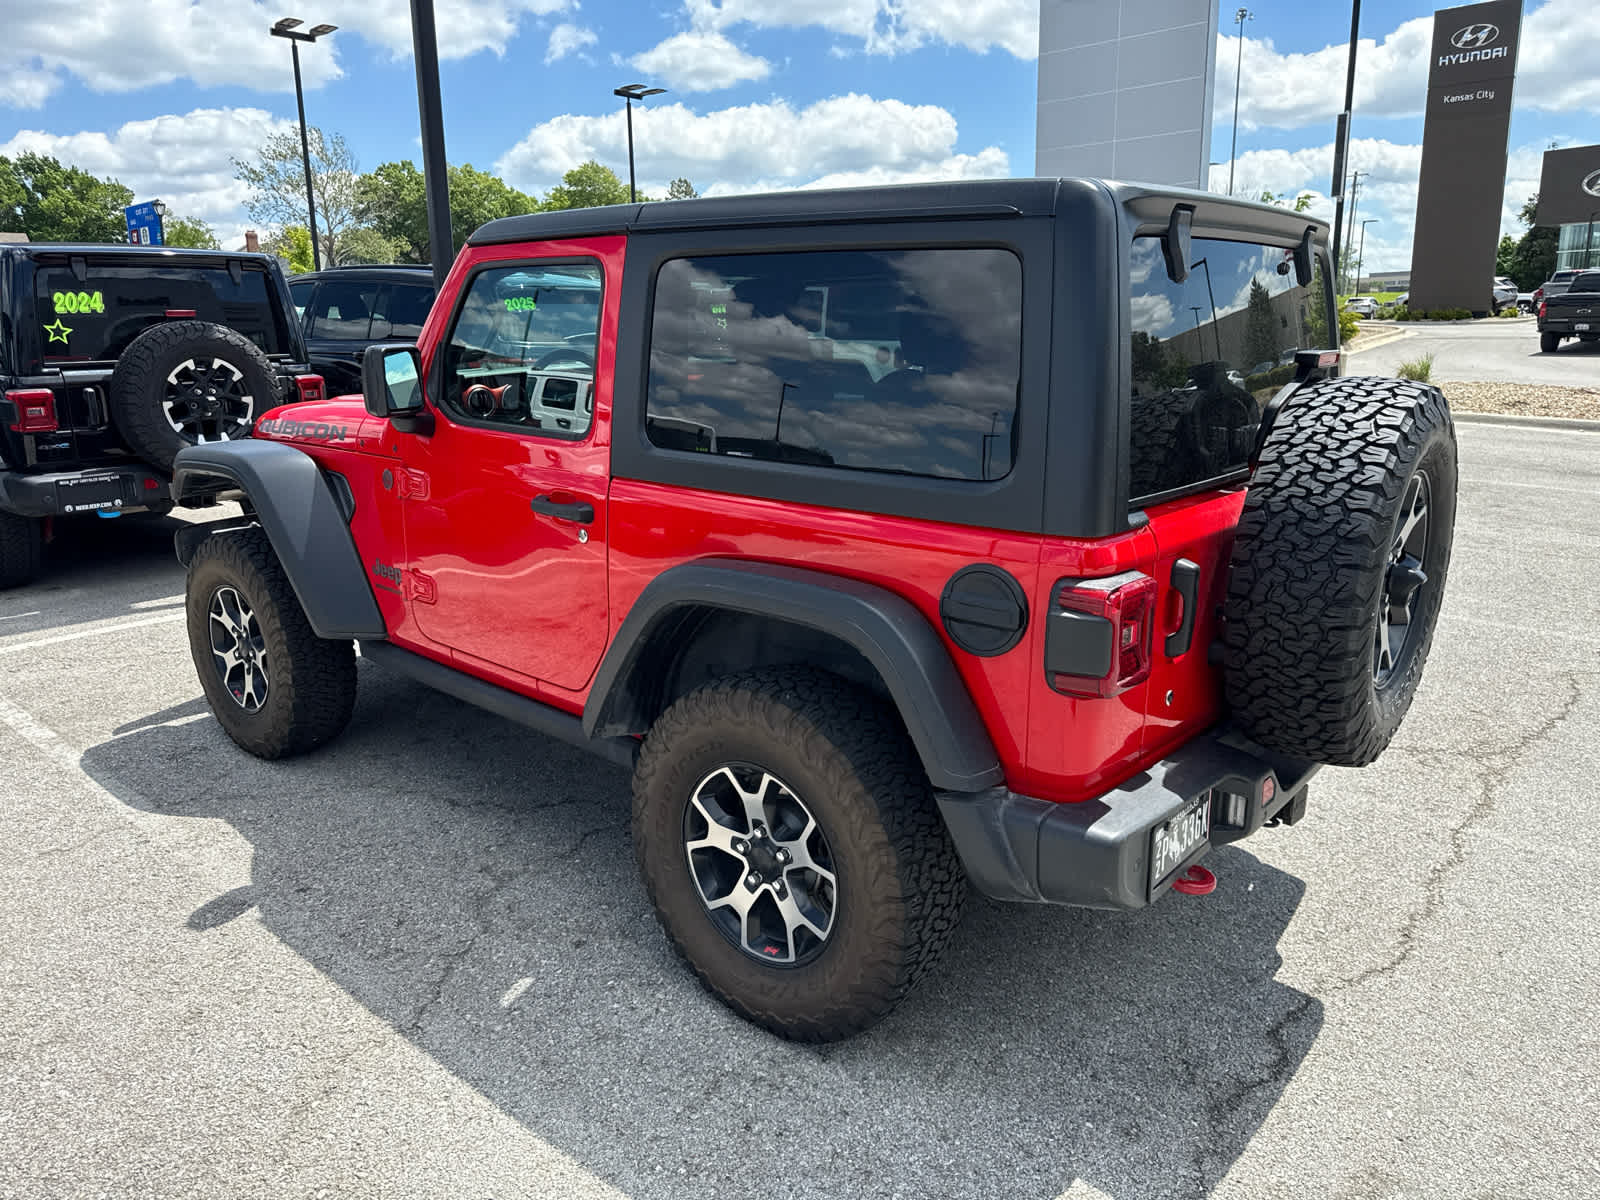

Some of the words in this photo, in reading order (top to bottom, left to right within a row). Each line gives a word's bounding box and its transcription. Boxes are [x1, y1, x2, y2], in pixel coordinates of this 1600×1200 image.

[1438, 46, 1508, 67] HYUNDAI
[1443, 91, 1474, 104] Kansas
[1476, 90, 1495, 101] City
[53, 291, 104, 314] 2024
[504, 296, 537, 312] 2025
[258, 419, 348, 441] RUBICON
[372, 558, 402, 585] Jeep
